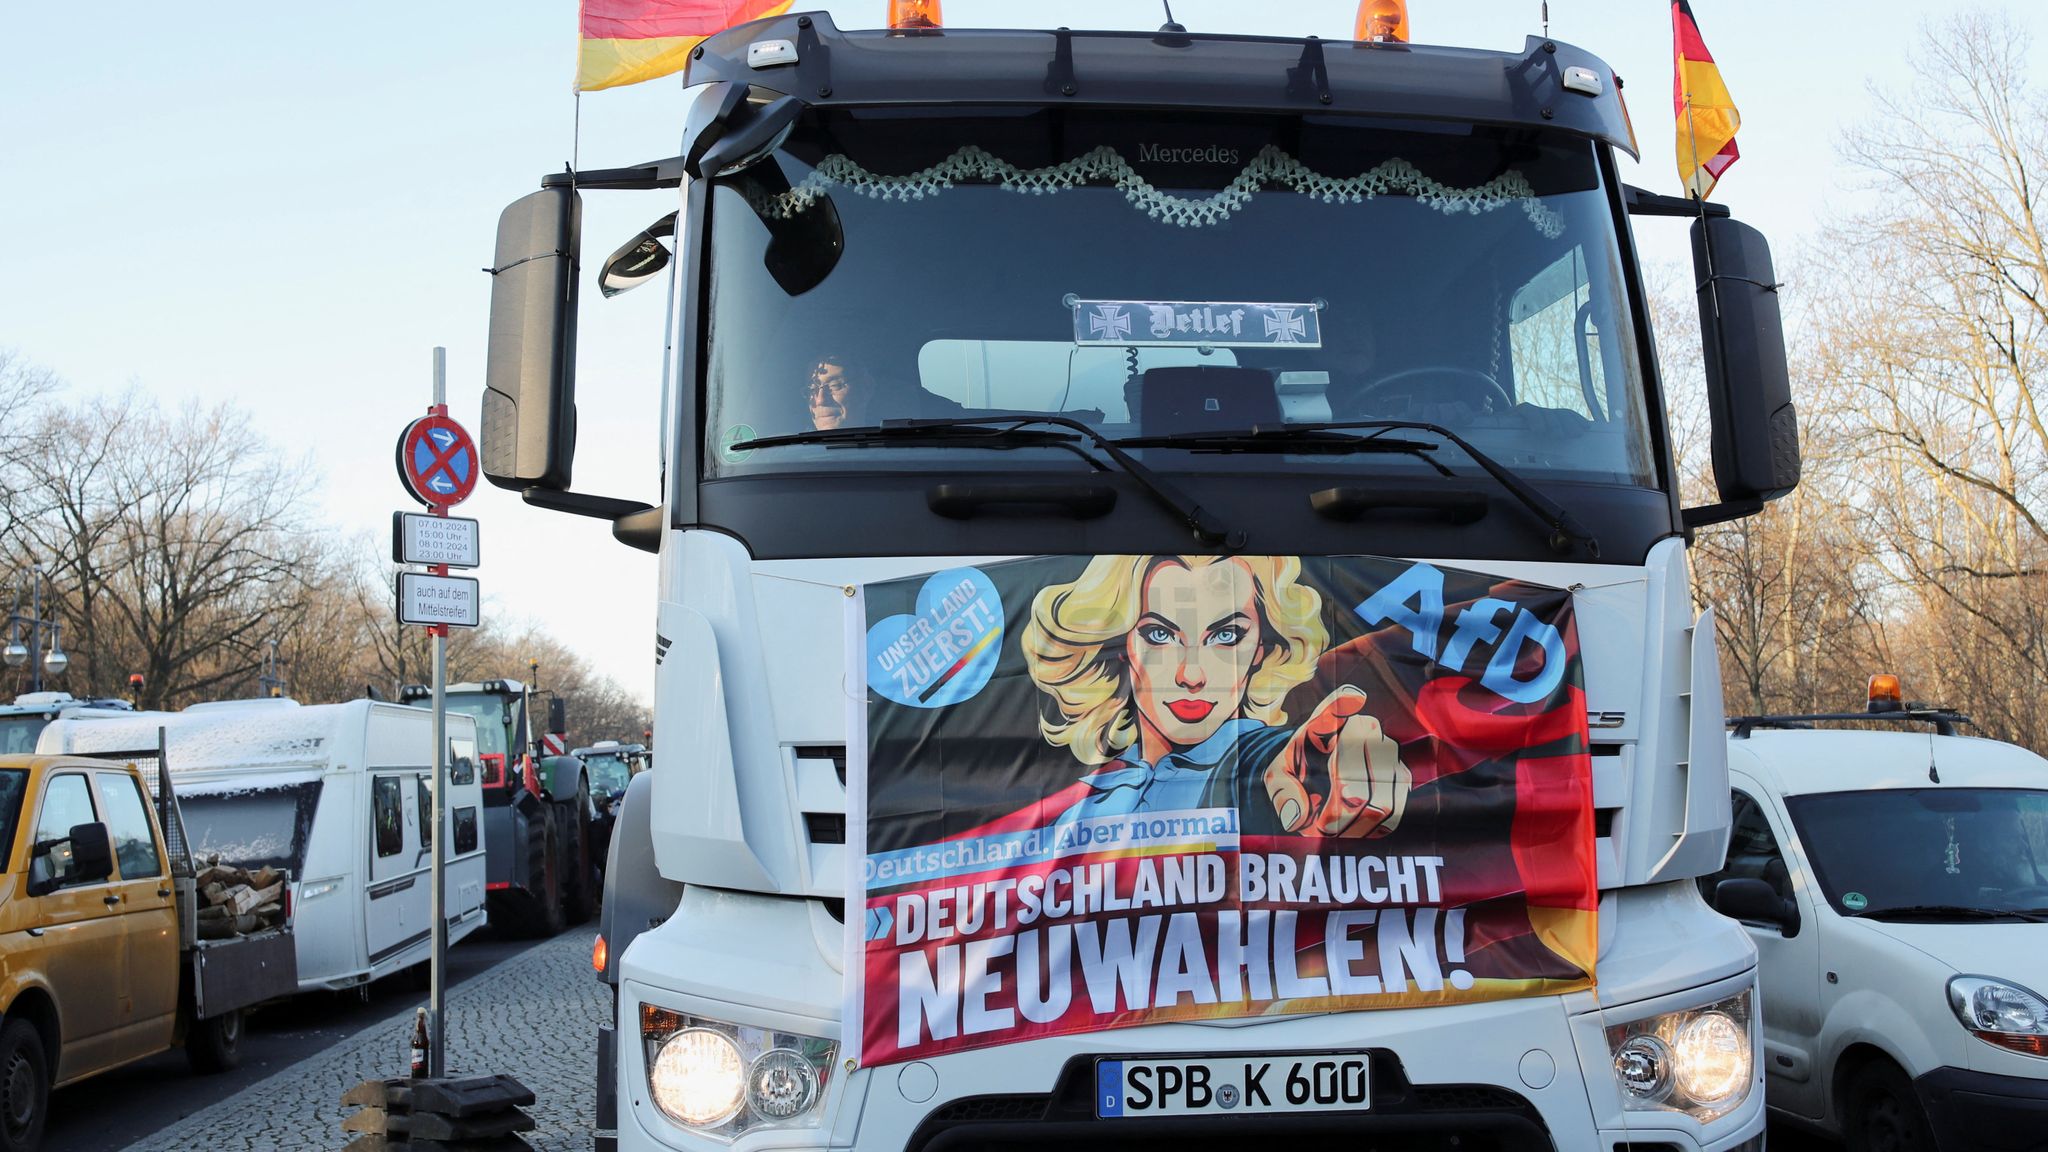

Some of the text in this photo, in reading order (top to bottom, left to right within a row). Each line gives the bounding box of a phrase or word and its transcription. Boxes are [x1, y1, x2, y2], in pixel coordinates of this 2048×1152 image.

[1139, 143, 1239, 164] Mercedes
[1150, 305, 1245, 338] Detlef
[418, 520, 467, 531] 07.01.2024
[419, 531, 443, 539] 15:00
[446, 532, 462, 541] Uhr
[418, 541, 468, 551] 08.01.2024
[418, 551, 462, 560] 23:00 Uhr
[416, 586, 468, 600] auch auf dem
[418, 602, 467, 618] Mittelstreifen
[877, 578, 977, 671] UNSER LAND
[1354, 561, 1567, 703] AfD
[892, 597, 996, 698] ZUERST!
[862, 808, 1239, 882] Deutschland. Aber normal
[896, 853, 1444, 946] DEUTSCHLAND BRAUCHT
[897, 908, 1476, 1048] NEUWAHLEN!
[1126, 1061, 1366, 1110] SPB K 600
[1105, 1095, 1116, 1108] D
